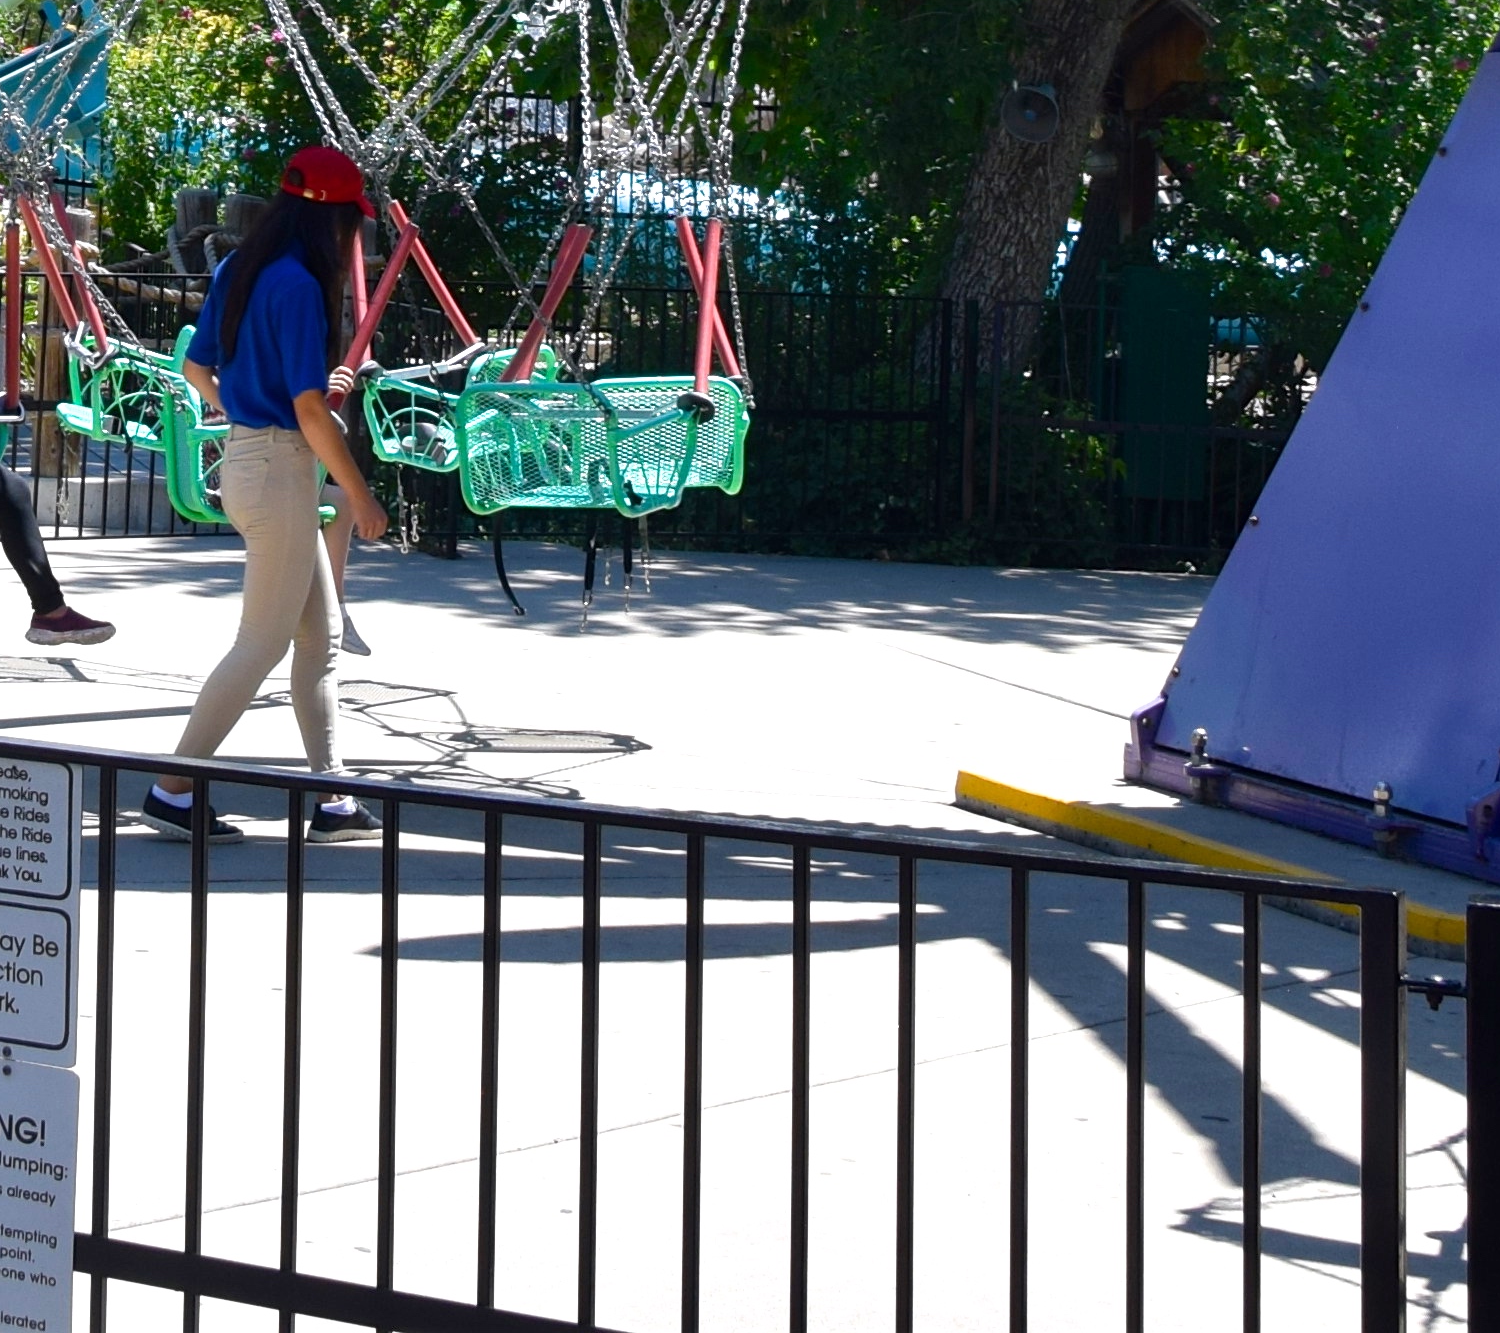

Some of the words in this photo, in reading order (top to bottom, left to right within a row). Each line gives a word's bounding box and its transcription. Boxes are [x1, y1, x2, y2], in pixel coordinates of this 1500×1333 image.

[13, 806, 50, 824] Rides
[21, 827, 53, 844] Ride
[15, 846, 48, 863] lines.
[13, 866, 43, 883] You.
[32, 933, 59, 957] Be
[6, 1182, 56, 1206] already
[0, 1246, 35, 1263] point.
[29, 1270, 57, 1286] who
